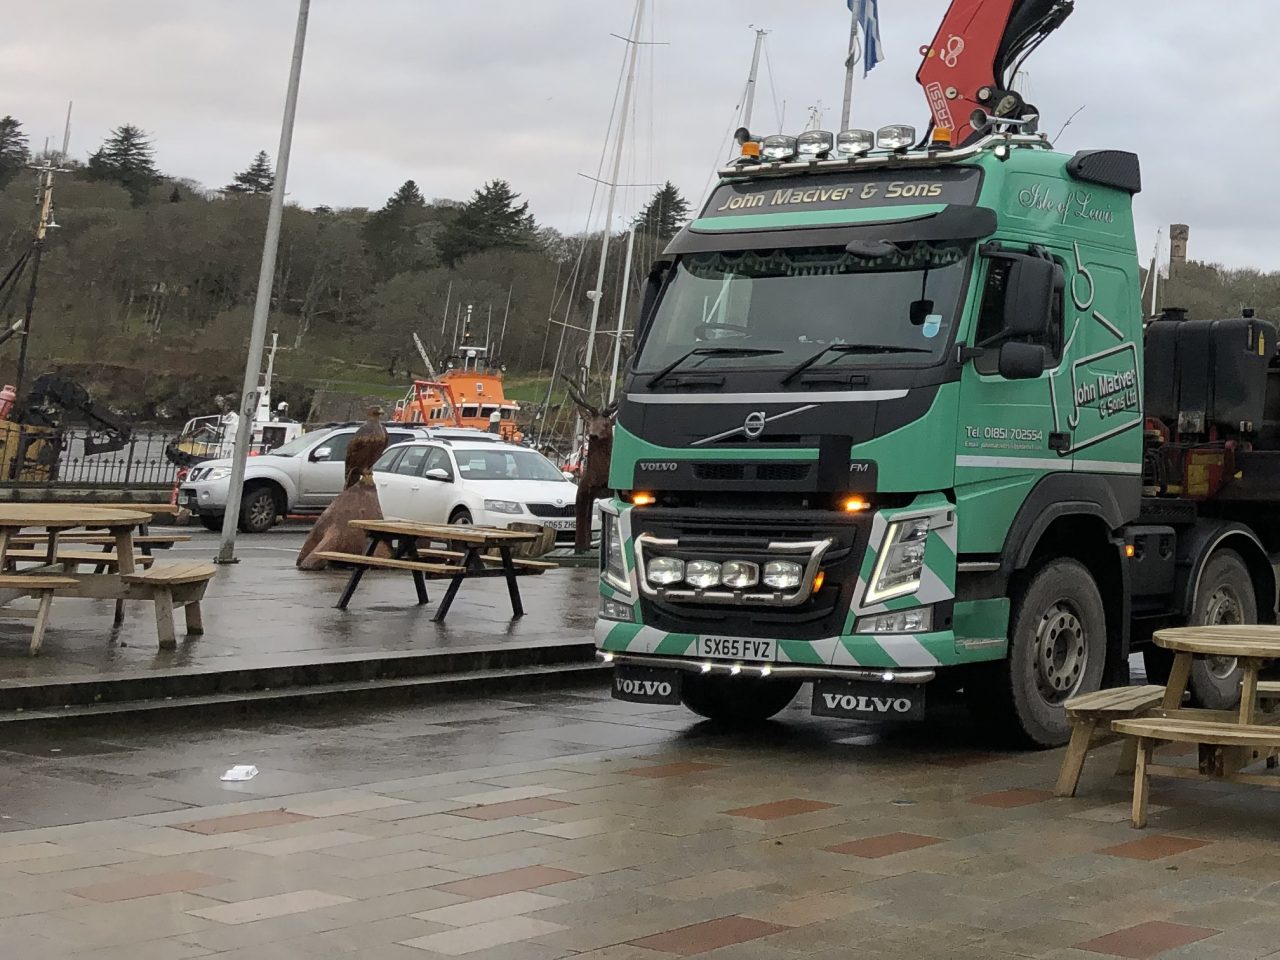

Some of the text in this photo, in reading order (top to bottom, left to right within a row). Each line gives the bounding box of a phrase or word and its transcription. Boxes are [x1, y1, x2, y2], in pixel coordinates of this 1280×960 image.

[929, 85, 951, 128] FASSI
[718, 193, 764, 212] John
[860, 182, 878, 199] &
[885, 181, 943, 198] Sons
[1018, 183, 1114, 225] Isle of Lewis
[1100, 389, 1138, 416] & Sons Ltd
[984, 426, 1008, 439] 01851
[1010, 428, 1043, 441] 702554
[640, 462, 678, 471] VOLVO
[850, 464, 869, 472] FM
[703, 638, 770, 658] SX65 FVZ
[616, 678, 672, 697] VOLVO
[822, 693, 912, 713] VOLVO
